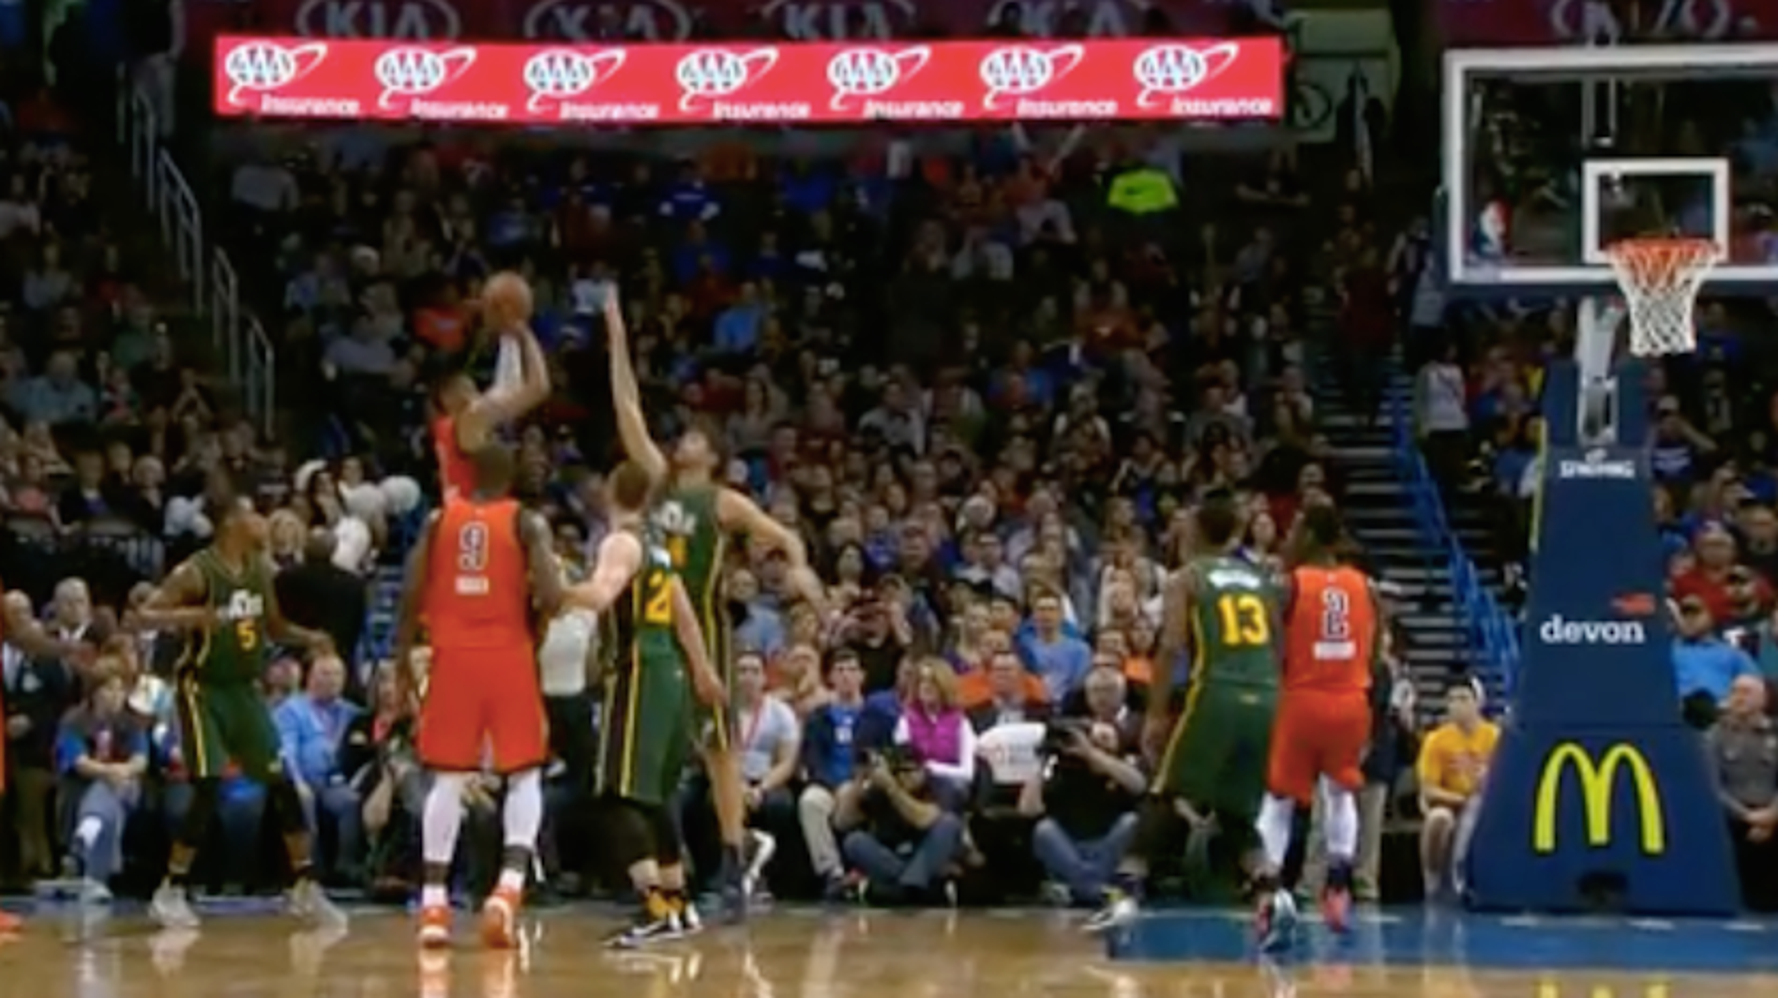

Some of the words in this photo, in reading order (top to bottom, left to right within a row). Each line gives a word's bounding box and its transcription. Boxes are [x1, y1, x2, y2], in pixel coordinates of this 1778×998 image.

[229, 46, 292, 84] AAA
[380, 49, 441, 87] AAA
[529, 52, 591, 90] AAA
[680, 52, 742, 90] AAA
[832, 51, 894, 88] AAA
[986, 49, 1046, 87] AAA
[1140, 47, 1201, 85] AAA
[260, 95, 360, 114] Insurance
[410, 99, 509, 119] Insurance
[560, 101, 659, 120] Insurance
[713, 101, 811, 119] Insurance
[862, 100, 964, 120] Insurance
[1016, 98, 1118, 117] Insurance
[1170, 97, 1272, 115] Insurance
[458, 521, 488, 571] 9
[1219, 593, 1269, 645] 13
[1323, 588, 1348, 642] 2
[1540, 614, 1644, 643] devon
[237, 620, 256, 650] 5
